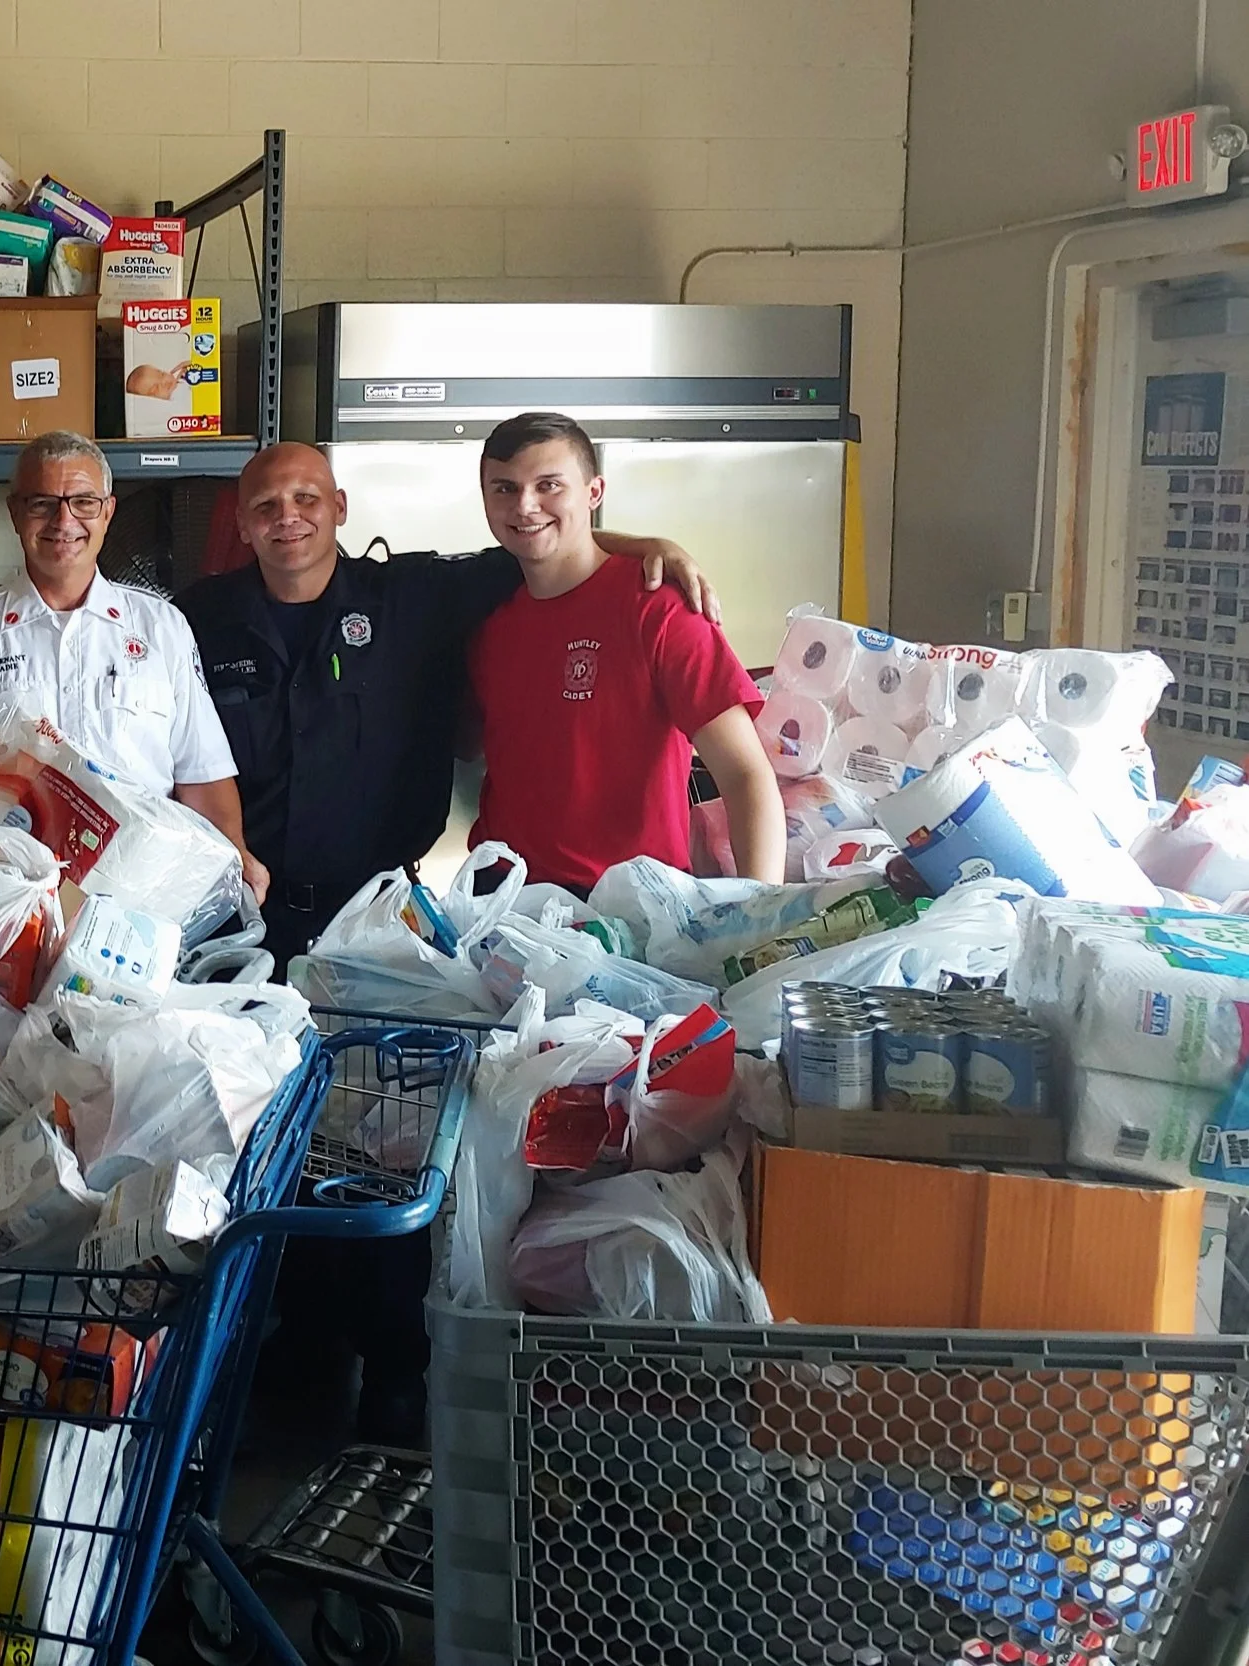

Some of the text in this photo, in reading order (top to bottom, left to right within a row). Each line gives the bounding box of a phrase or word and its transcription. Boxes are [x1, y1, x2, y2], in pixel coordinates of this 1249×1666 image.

[1137, 111, 1197, 192] EXIT
[119, 229, 162, 242] HUGGIES
[124, 256, 155, 264] EXTRA
[107, 265, 172, 274] ABSORBENCY
[127, 306, 188, 322] HUGGIES
[197, 306, 213, 317] 12
[139, 323, 178, 331] Snug & Dry
[15, 371, 55, 388] SIZE2
[181, 418, 199, 428] 140
[567, 639, 602, 651] HUNTLEY
[562, 690, 593, 700] CADET
[1151, 1006, 1166, 1034] USA
[889, 1078, 918, 1087] Green
